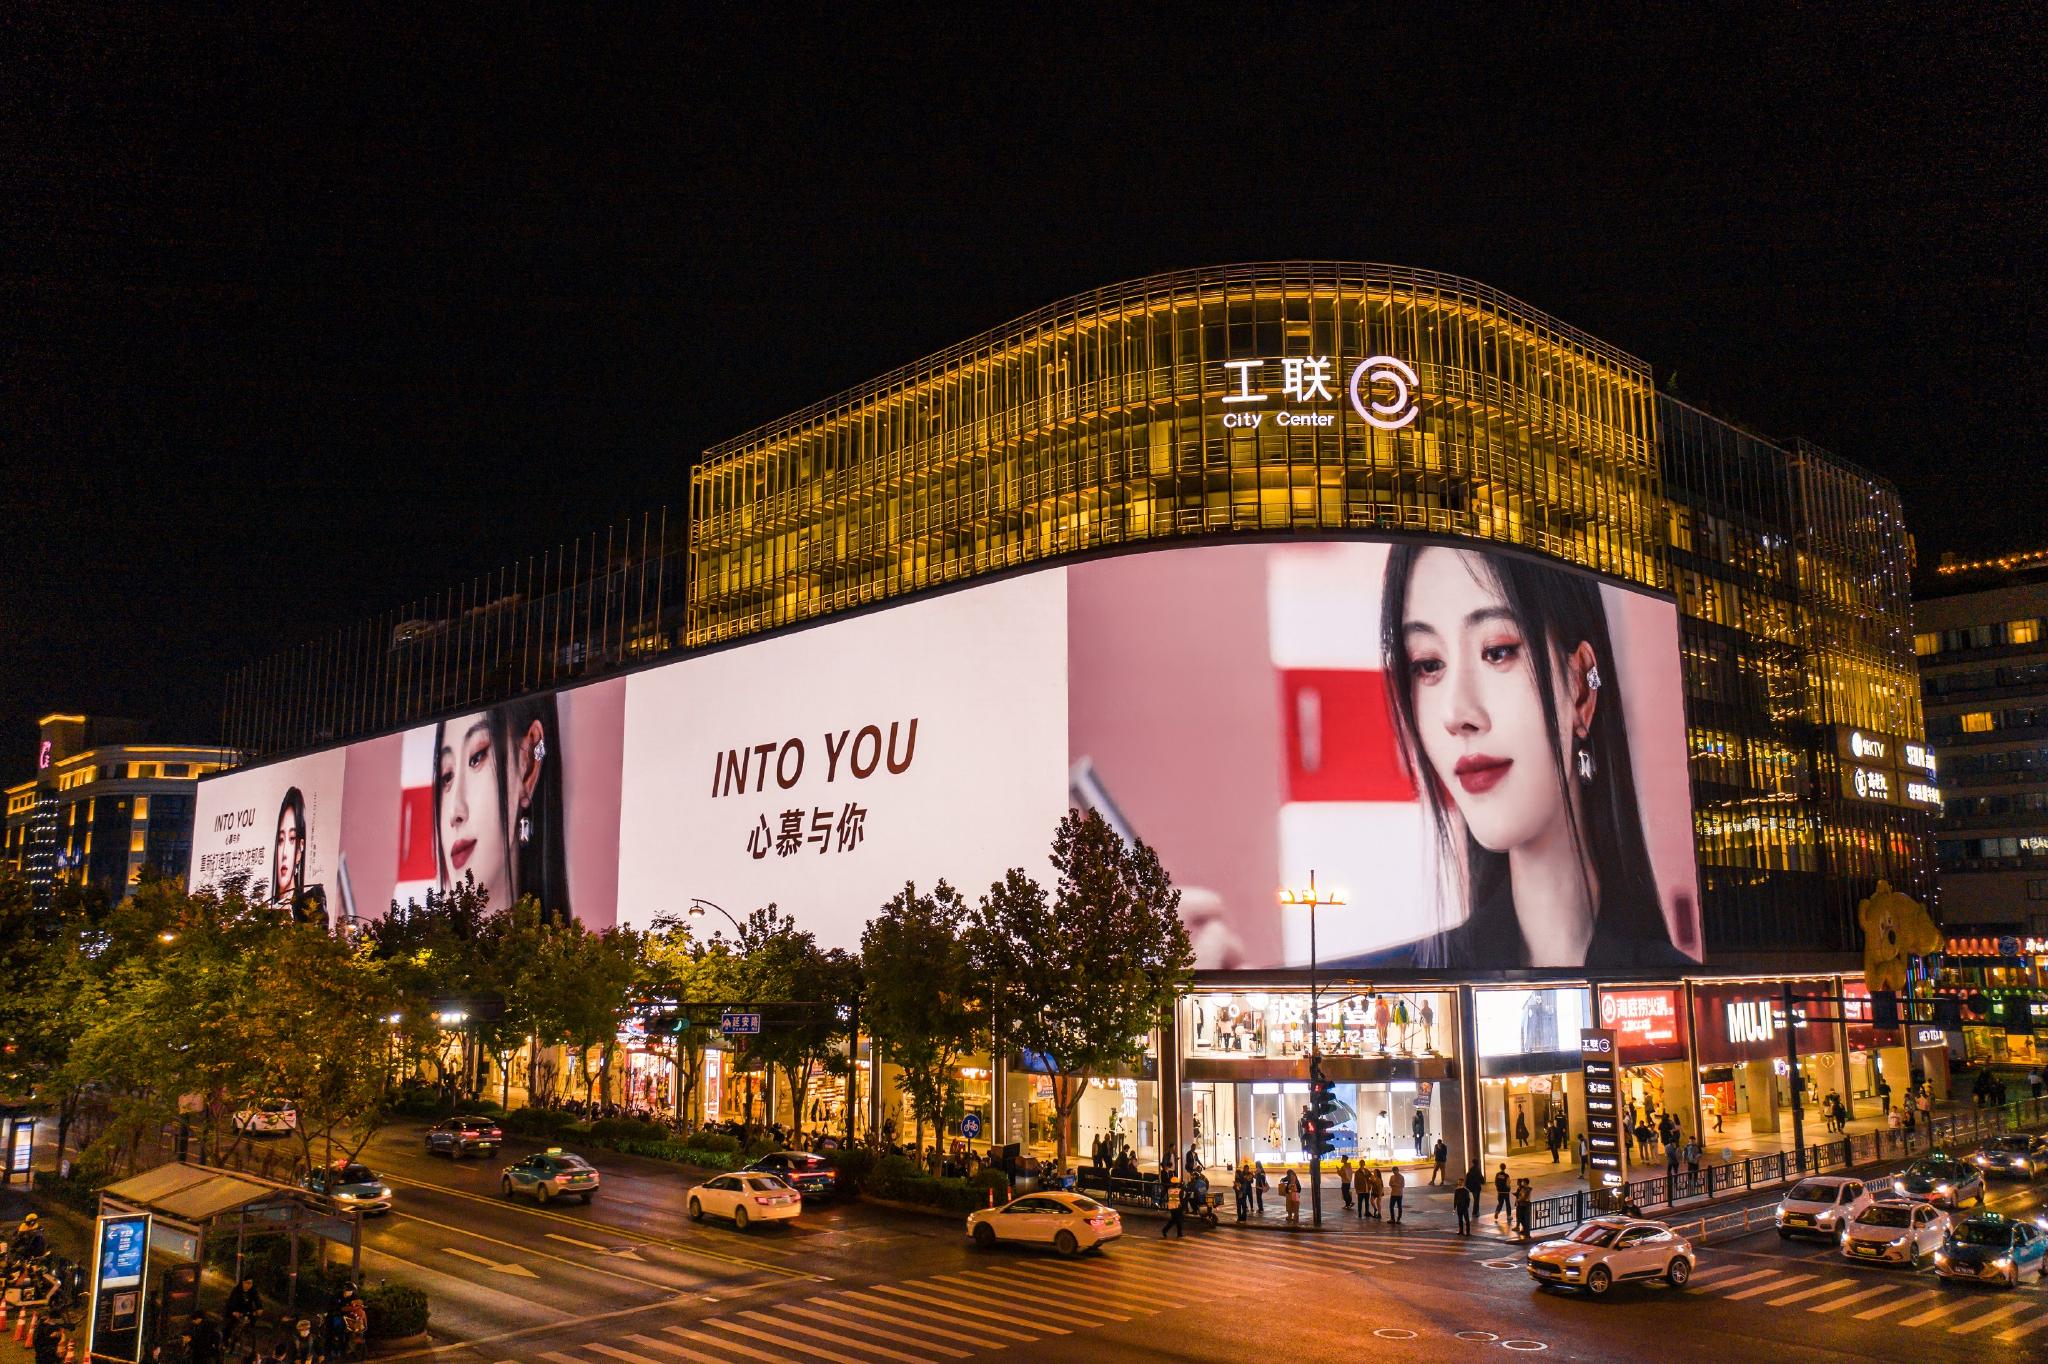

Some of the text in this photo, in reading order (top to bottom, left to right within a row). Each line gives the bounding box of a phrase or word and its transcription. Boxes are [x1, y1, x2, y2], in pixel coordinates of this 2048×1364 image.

[1221, 355, 1333, 403] 工联
[1223, 412, 1335, 429] City Center
[711, 718, 918, 798] INTO YOU
[214, 808, 256, 832] INTO YOU
[746, 802, 868, 860] 心慕与你
[733, 1016, 758, 1027] 延安路
[1727, 1001, 1773, 1043] MUJI
